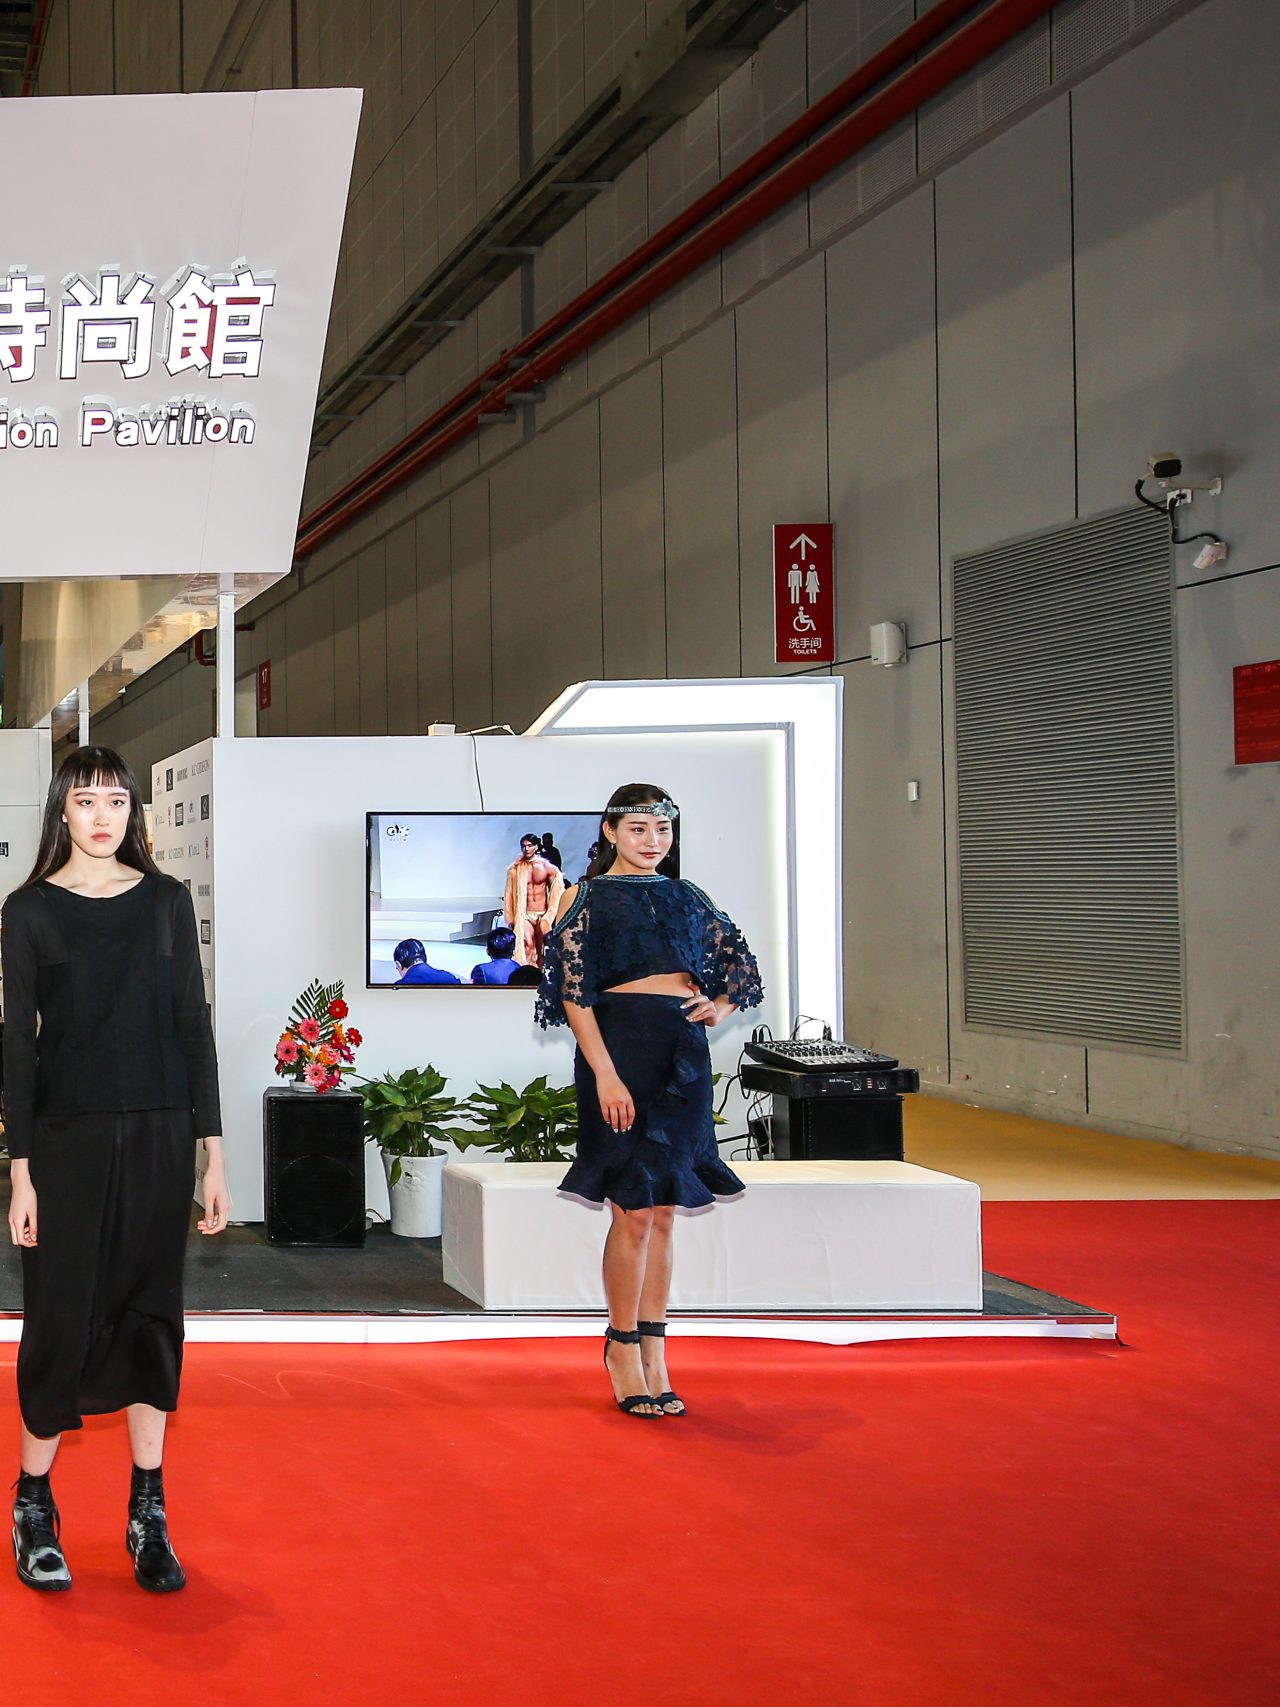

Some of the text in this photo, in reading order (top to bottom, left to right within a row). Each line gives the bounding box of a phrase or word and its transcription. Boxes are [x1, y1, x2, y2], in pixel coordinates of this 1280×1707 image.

[81, 405, 257, 448] Pavilion
[788, 637, 822, 649] 洗手间
